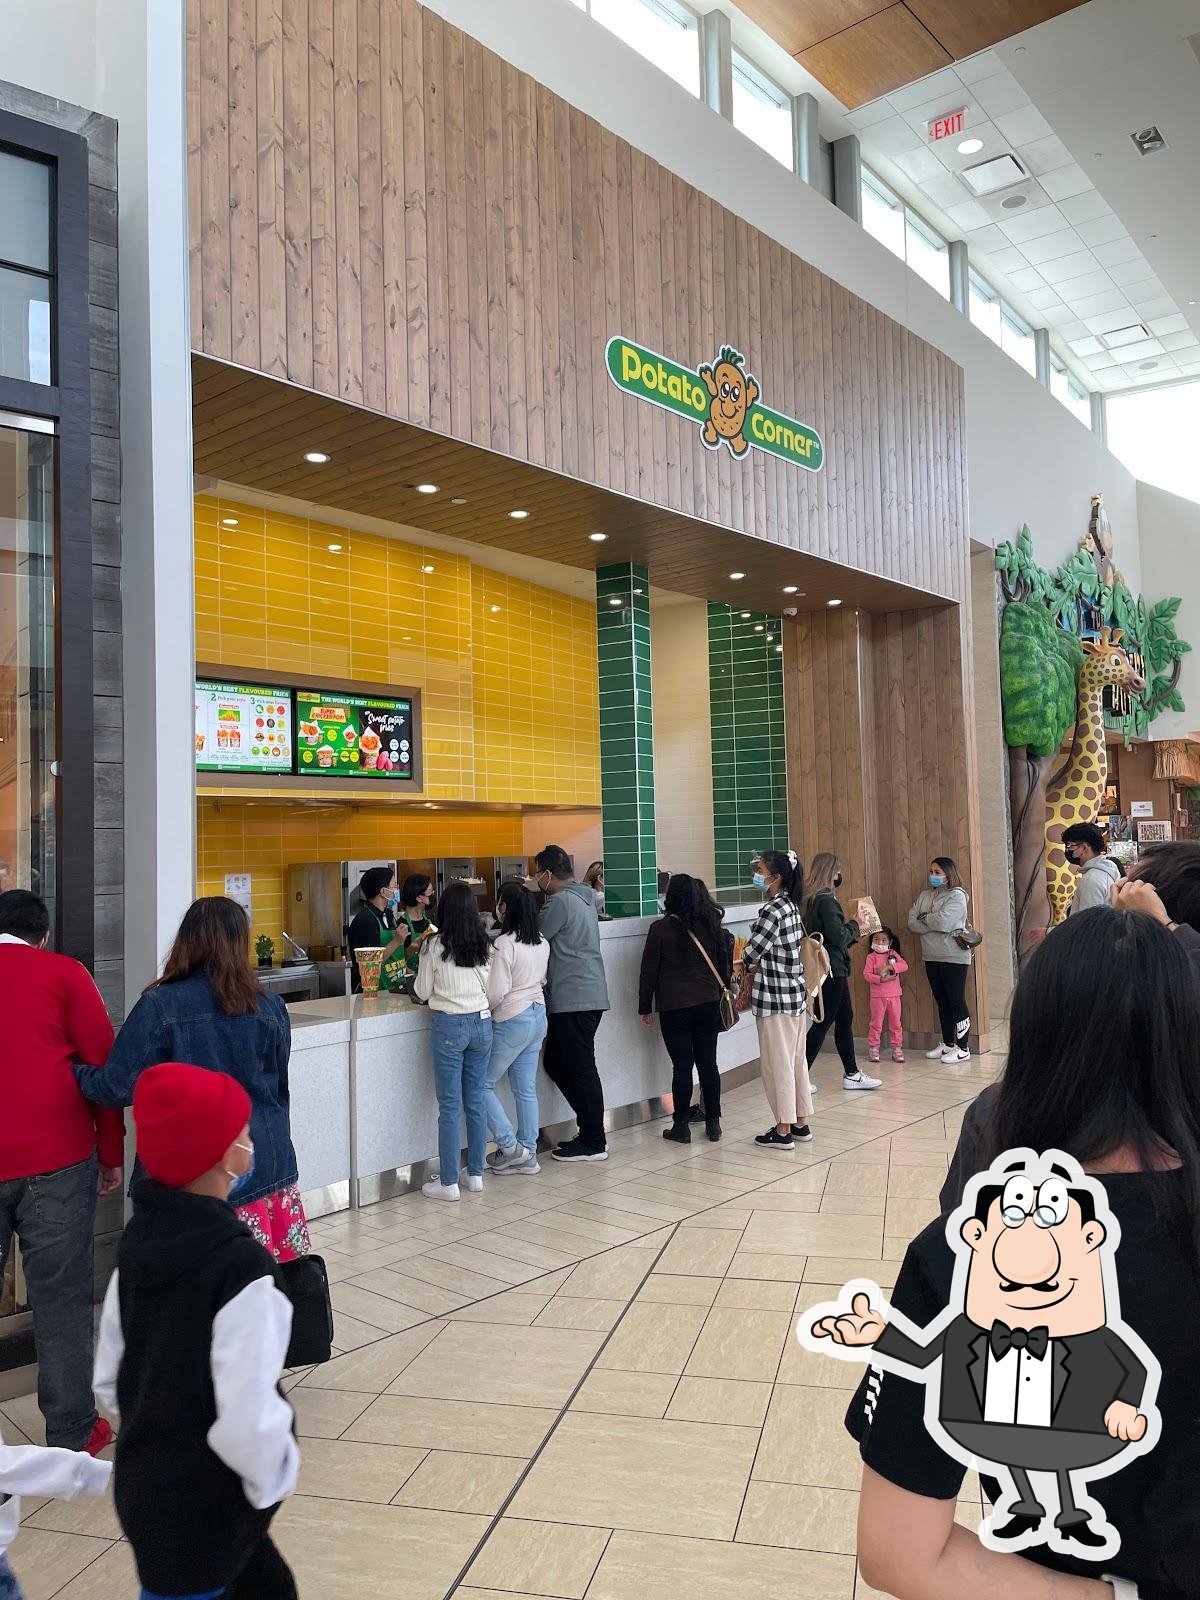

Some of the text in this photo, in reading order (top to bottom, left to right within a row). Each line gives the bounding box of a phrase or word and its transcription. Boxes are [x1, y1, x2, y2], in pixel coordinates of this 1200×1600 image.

[935, 113, 962, 140] EXIT
[621, 345, 706, 411] Potato
[211, 693, 217, 701] 2
